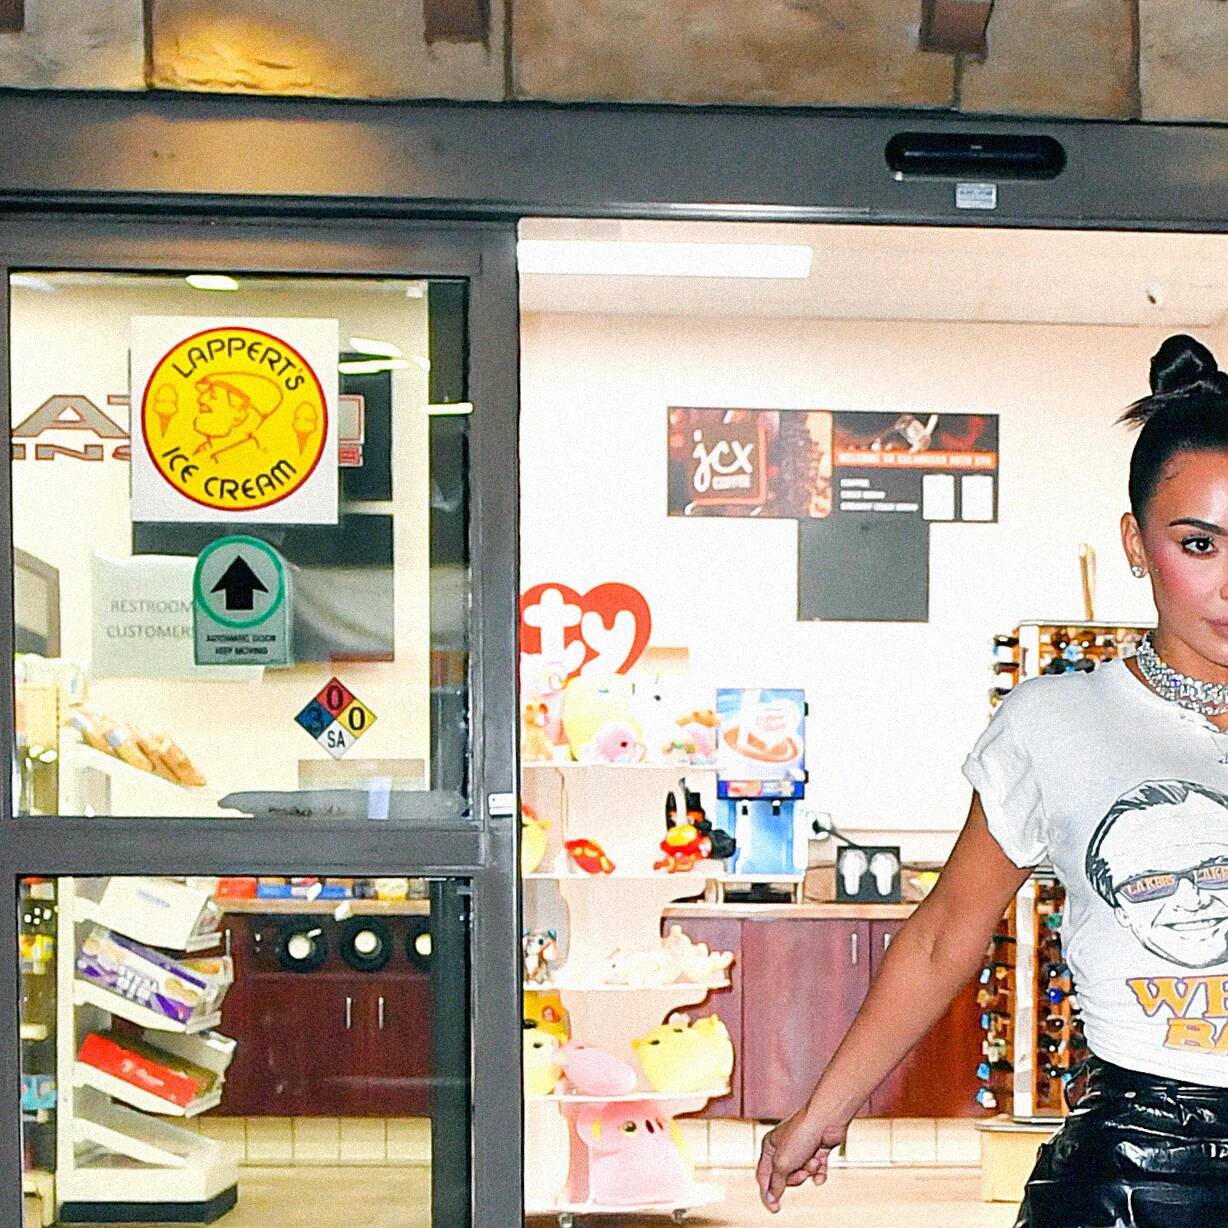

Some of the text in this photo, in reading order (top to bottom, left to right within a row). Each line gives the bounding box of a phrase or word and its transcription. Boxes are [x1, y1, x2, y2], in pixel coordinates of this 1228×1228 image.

[172, 337, 306, 391] LAPPERT'S
[162, 446, 200, 483] ICE
[203, 459, 297, 501] CREAM
[692, 428, 754, 493] jcx
[523, 588, 637, 679] ty
[325, 685, 344, 711] 0
[348, 706, 366, 731] 0
[327, 730, 346, 749] SA
